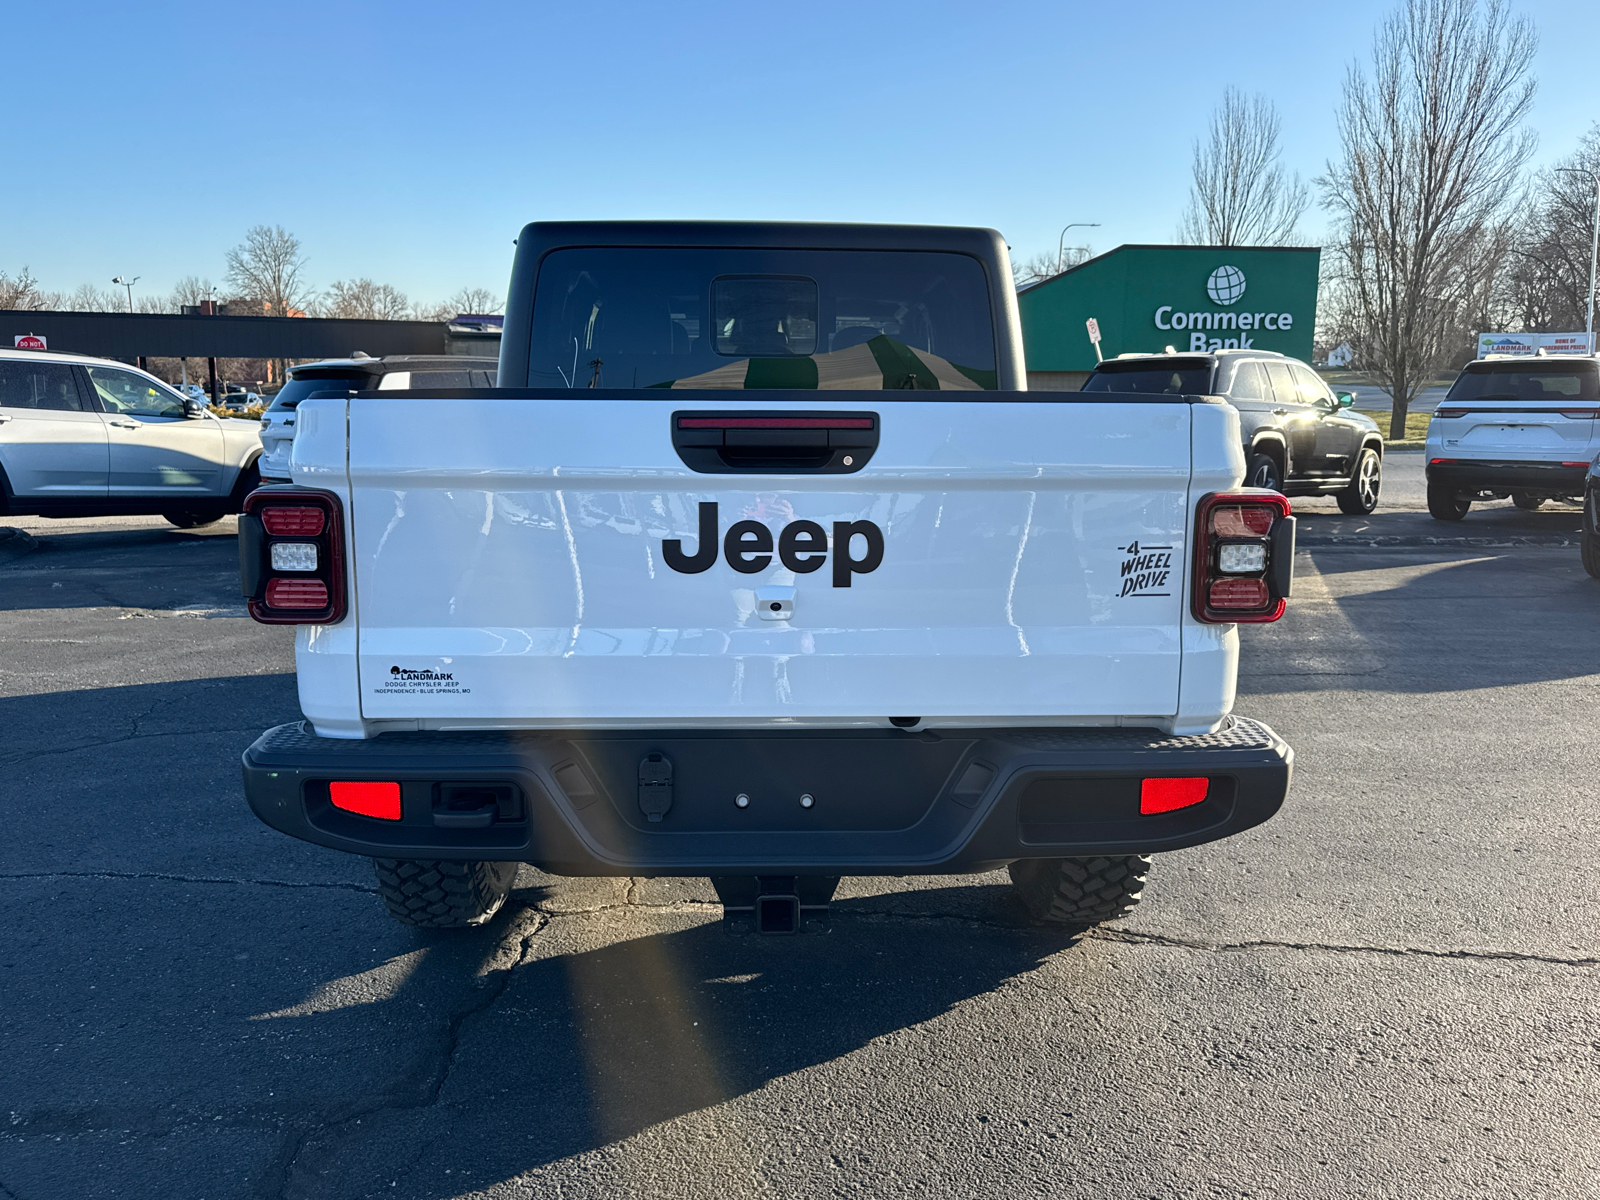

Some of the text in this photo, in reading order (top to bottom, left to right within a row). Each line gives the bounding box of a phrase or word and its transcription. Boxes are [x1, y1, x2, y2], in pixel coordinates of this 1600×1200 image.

[1154, 305, 1293, 330] Commerce
[1189, 332, 1254, 352] Bank
[662, 502, 884, 587] Jeep
[1127, 540, 1140, 556] 4
[1121, 553, 1171, 577] WHEEL
[1121, 571, 1170, 598] DRIVE
